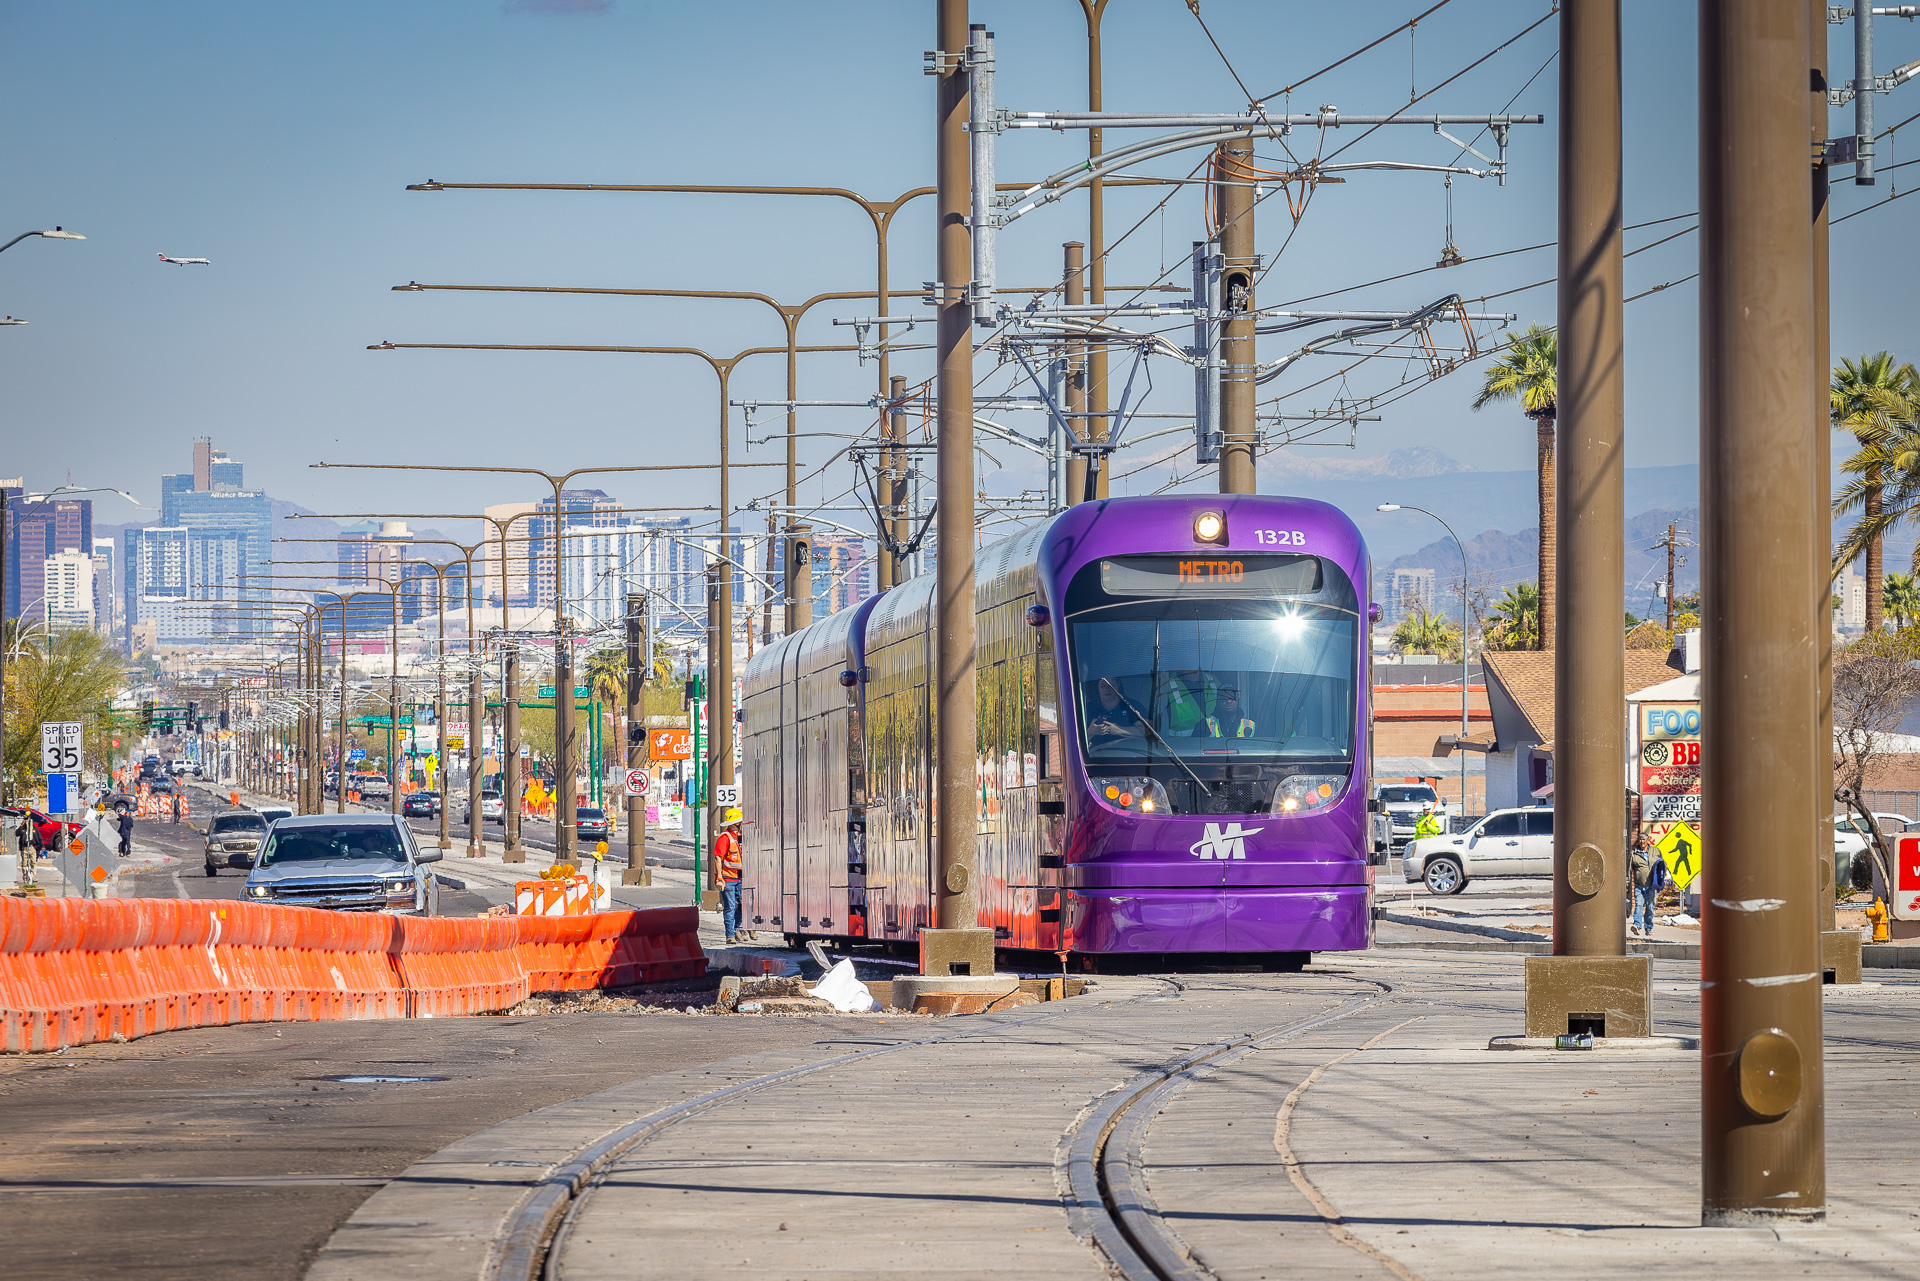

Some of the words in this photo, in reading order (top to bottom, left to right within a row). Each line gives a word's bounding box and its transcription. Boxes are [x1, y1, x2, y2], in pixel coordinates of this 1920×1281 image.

[1254, 529, 1306, 546] 132B
[1179, 560, 1244, 583] METRO
[47, 747, 78, 769] 35
[717, 789, 736, 802] 35
